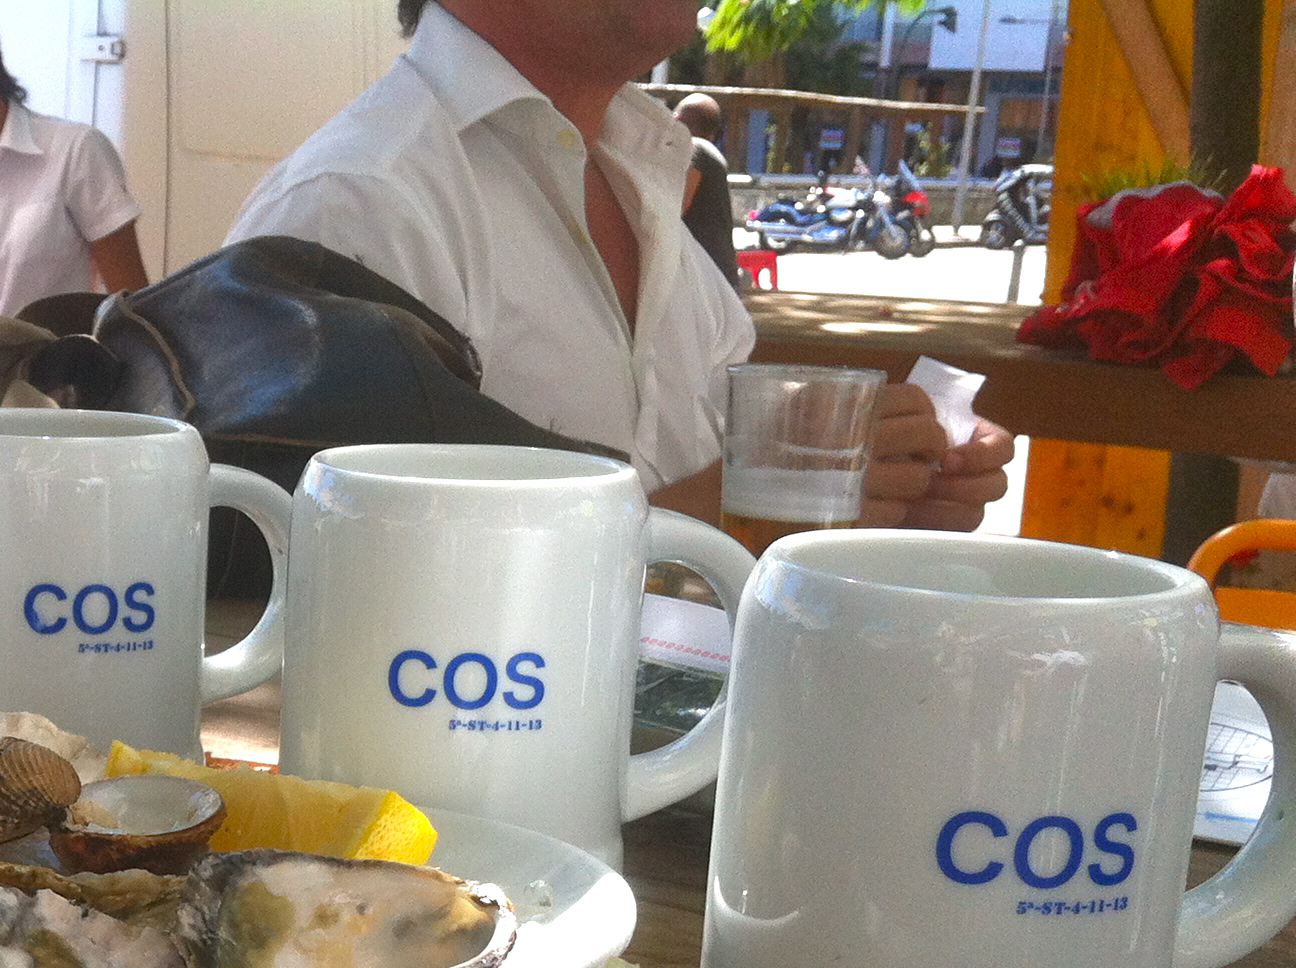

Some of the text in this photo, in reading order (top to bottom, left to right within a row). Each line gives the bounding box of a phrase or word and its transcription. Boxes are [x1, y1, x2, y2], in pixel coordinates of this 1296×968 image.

[24, 582, 155, 635] COS
[389, 649, 547, 711] COS
[935, 811, 1138, 889] COS
